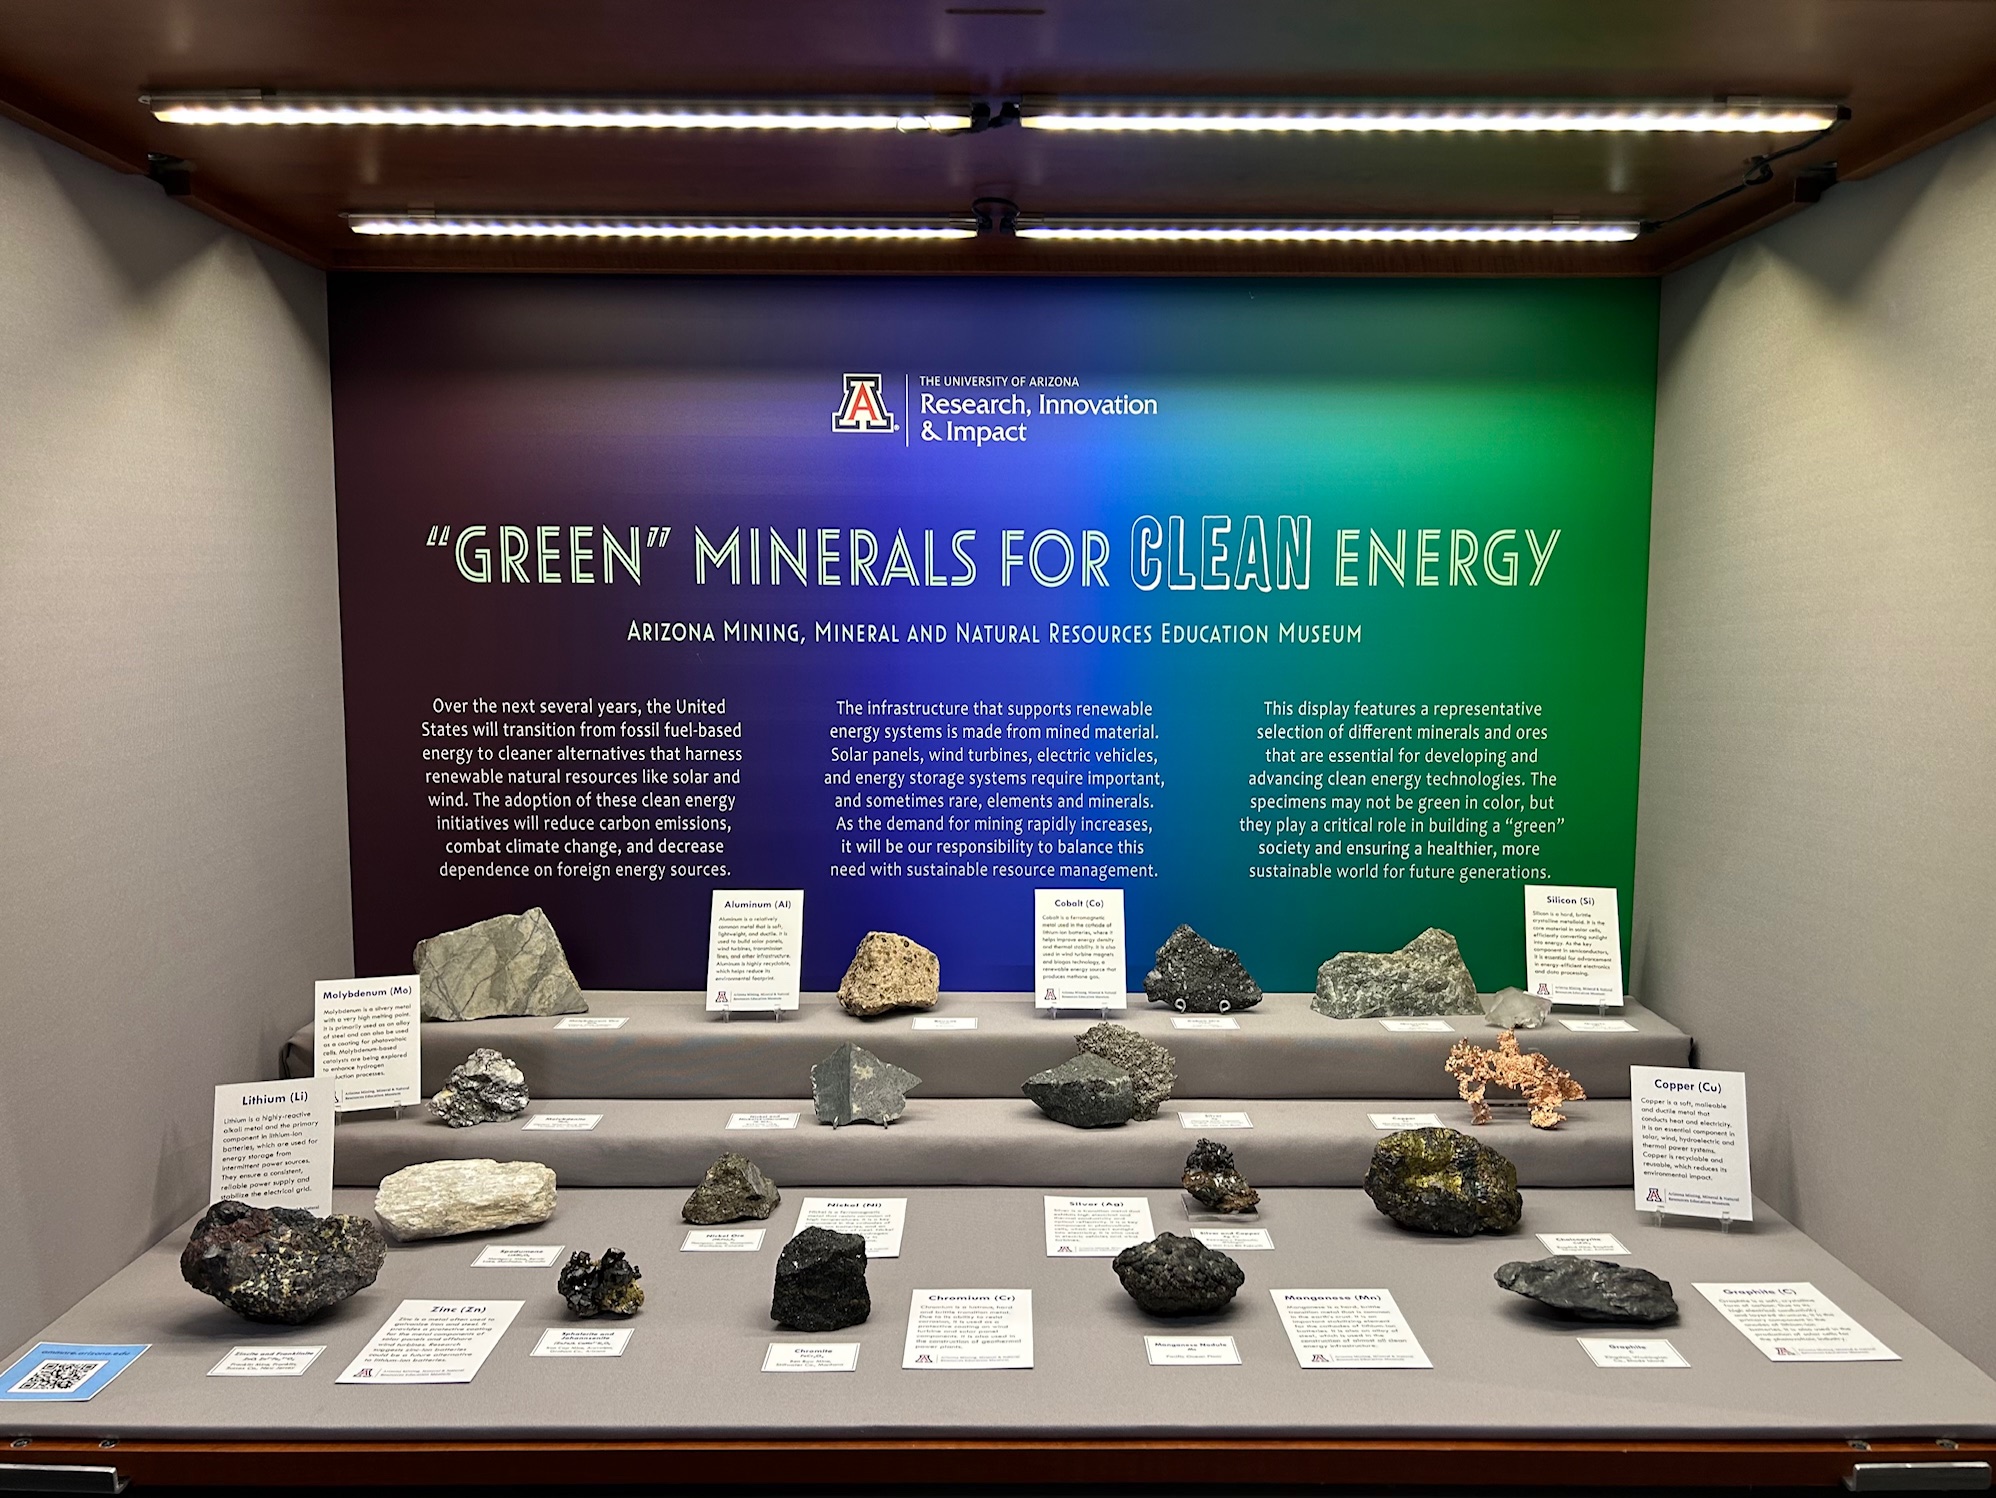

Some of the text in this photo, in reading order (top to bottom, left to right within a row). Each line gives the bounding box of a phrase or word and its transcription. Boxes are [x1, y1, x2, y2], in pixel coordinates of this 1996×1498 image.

[920, 376, 1079, 387] THE UNIVERSITY OF ARIZONA
[921, 393, 1157, 417] Research, Innovation
[921, 420, 1027, 447] & Impact
[695, 526, 976, 587] MINERALS
[1002, 529, 1109, 587] FOR
[1131, 515, 1311, 592] CLEAN
[1336, 528, 1561, 587] ENERGY
[433, 697, 726, 717] Over the next several years, the United
[836, 699, 1152, 720] The infrastructure that supports renewable
[1264, 700, 1542, 720] This display features a representative
[422, 721, 742, 737] States will transition from fossil fuel-based
[830, 723, 1159, 743] energy systems is made from mined material.
[1257, 723, 1548, 740] selection of different minerals and ores
[422, 745, 742, 765] energy to cleaner alternatives that harness
[831, 746, 1158, 766] Solar panels, wind turbines, electric vehicles,
[1265, 747, 1538, 768] that are essential for developing and
[426, 768, 740, 784] renewable natural resources like solar and
[824, 769, 1164, 789] and energy storage systems require important,
[1248, 770, 1557, 790] advancing clean energy technologies. The
[724, 900, 792, 910] Aluminum (Al)
[1054, 900, 1104, 908] Cobalt (Co)
[1546, 896, 1595, 906] Silicon (Si)
[323, 986, 412, 1000] Molybdenum (Mo)
[1654, 1079, 1722, 1094] Copper (Cu)
[242, 1091, 309, 1106] Lithium (Li)
[1640, 1098, 1664, 1106] Copper
[1690, 1172, 1713, 1181] impact.
[994, 1294, 1016, 1302] (Cr)
[1284, 1294, 1382, 1302] Manganese (Mn)
[1722, 1288, 1797, 1296] Graphite (C)
[460, 1305, 486, 1314] (Zn)
